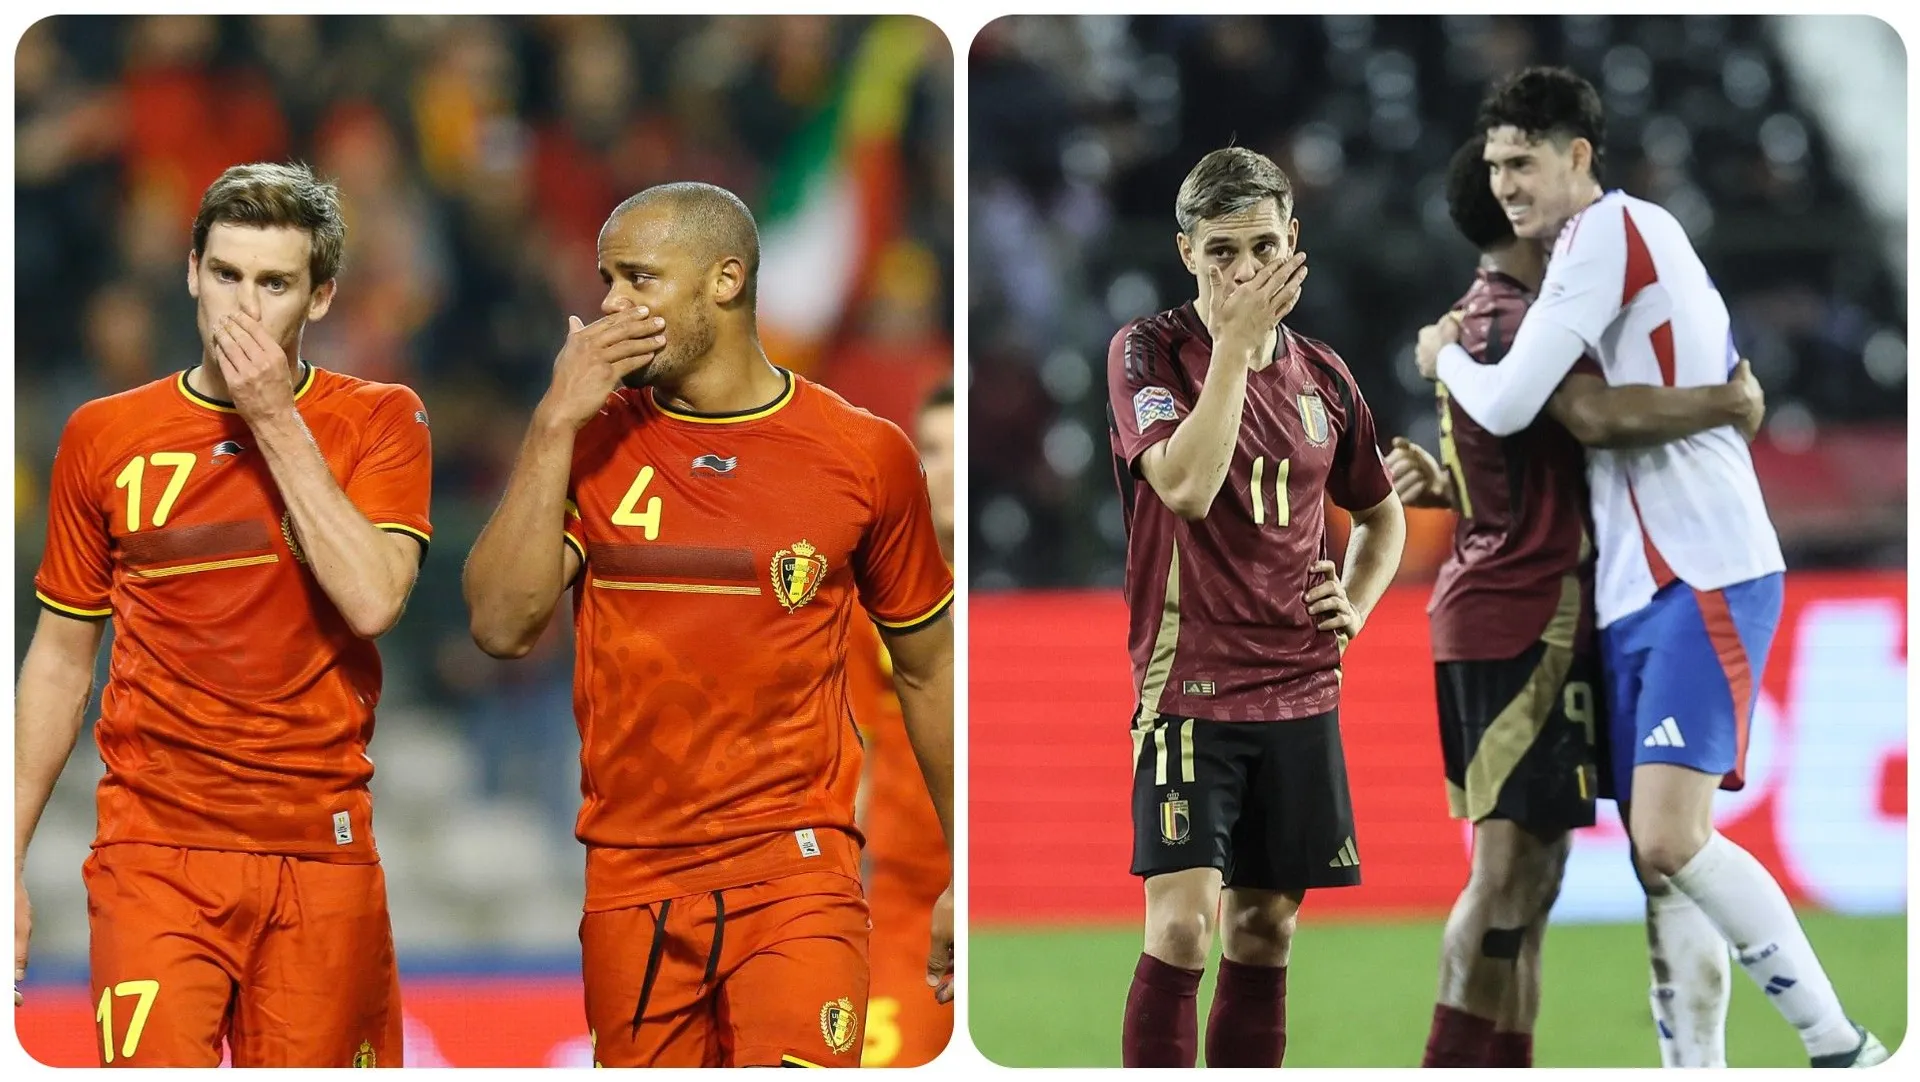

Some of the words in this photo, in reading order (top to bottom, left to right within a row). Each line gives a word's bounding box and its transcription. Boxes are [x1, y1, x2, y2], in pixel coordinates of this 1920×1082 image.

[115, 452, 197, 532] 17
[611, 465, 663, 541] 4
[1250, 455, 1290, 527] 11
[1563, 681, 1595, 746] 9
[1154, 718, 1196, 786] 11
[96, 979, 160, 1064] 17
